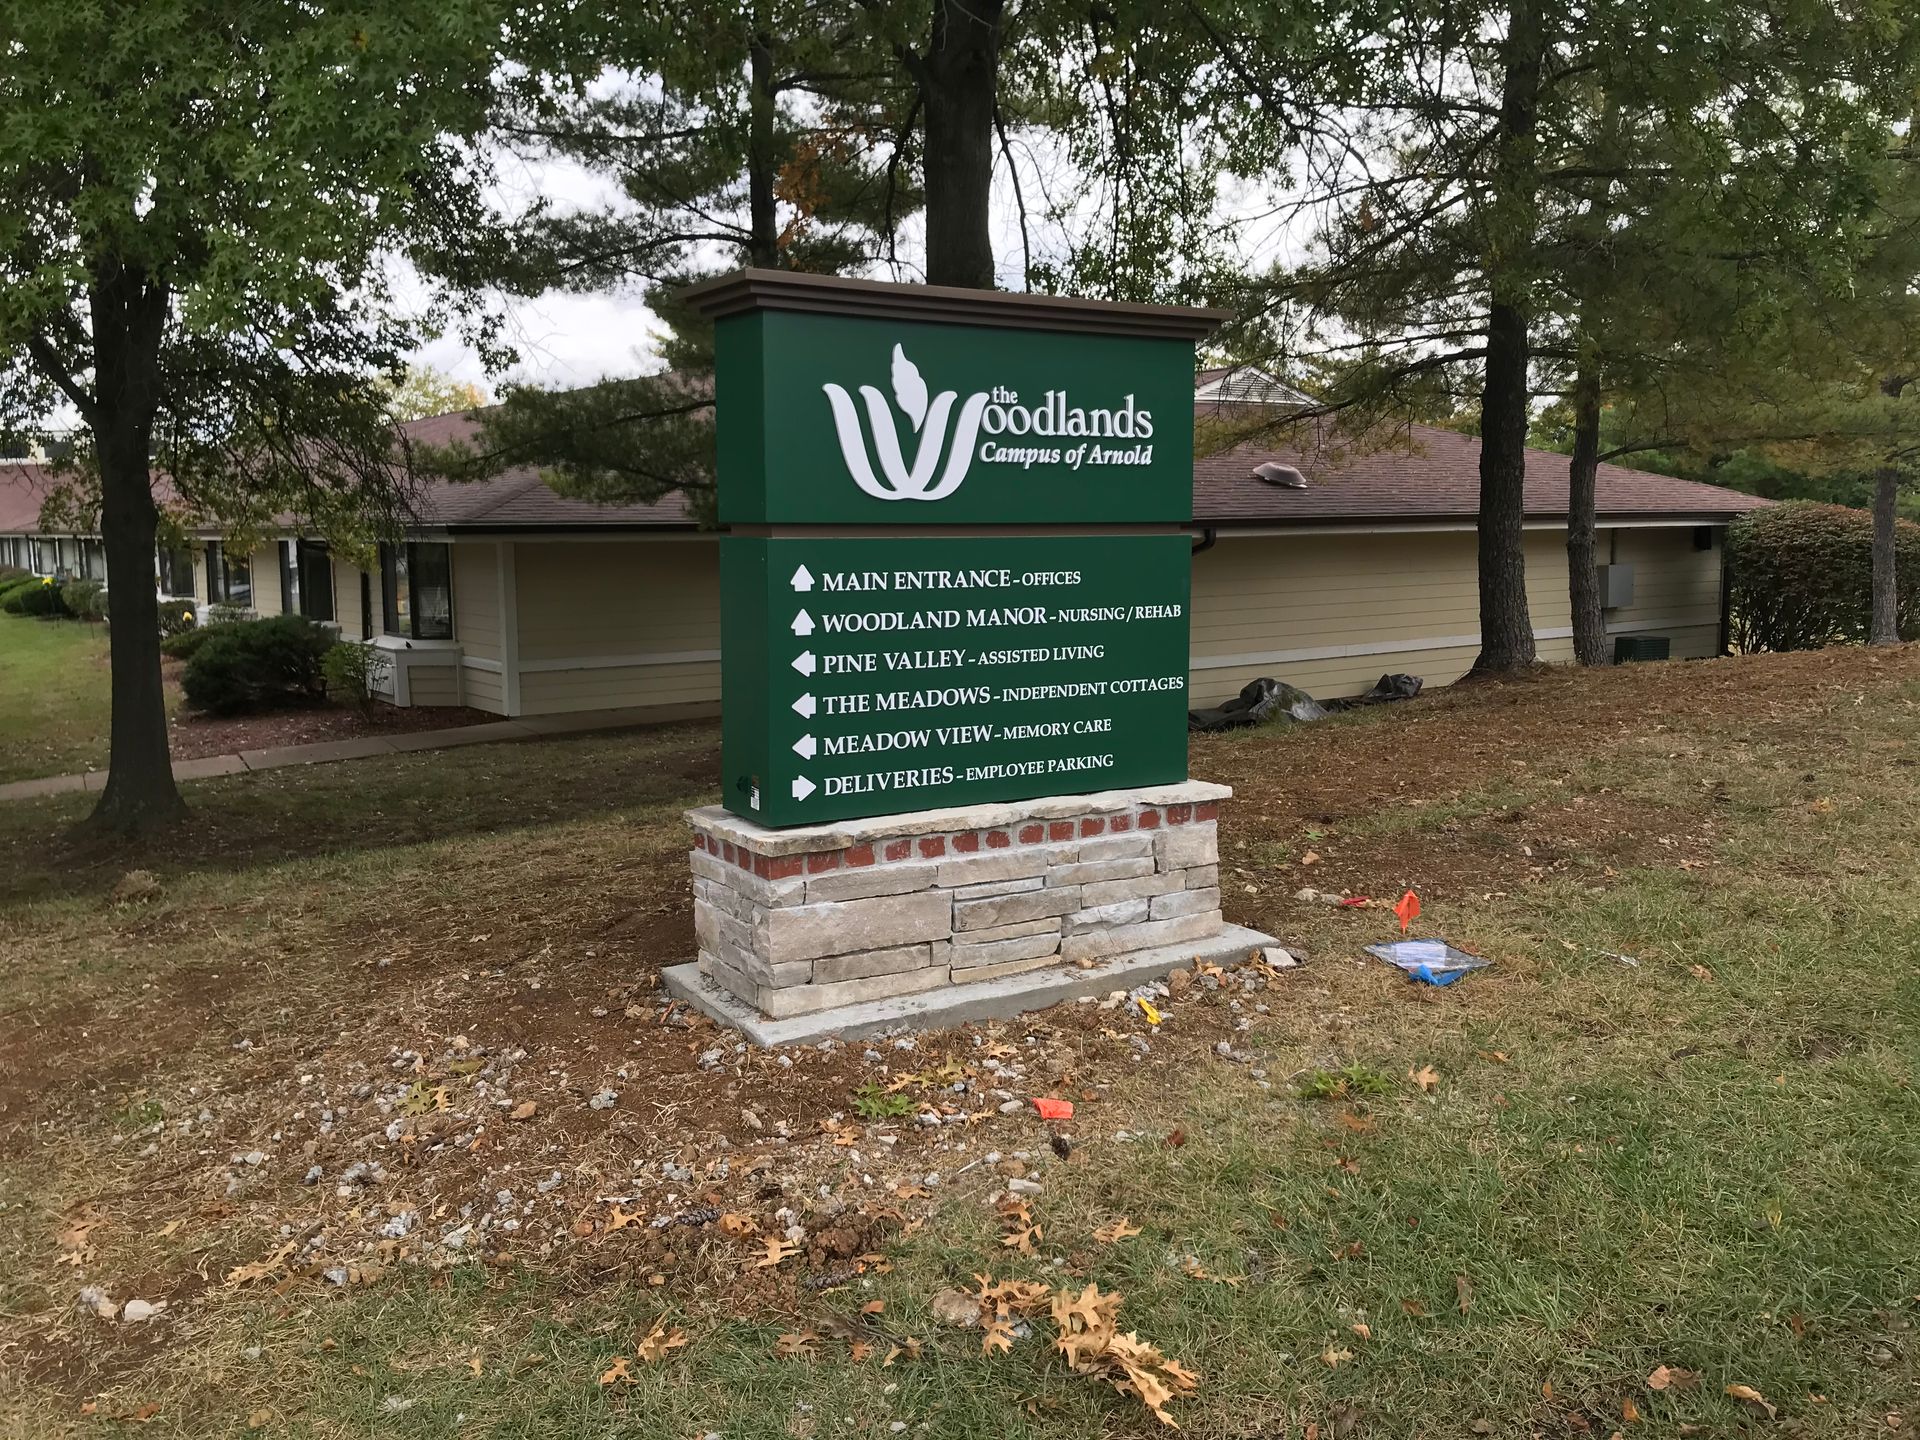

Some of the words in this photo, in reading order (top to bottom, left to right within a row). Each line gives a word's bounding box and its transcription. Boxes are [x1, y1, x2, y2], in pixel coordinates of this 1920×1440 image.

[990, 385, 1019, 405] the
[979, 441, 1061, 470] Campus
[1064, 442, 1088, 471] of
[1086, 444, 1153, 466] Arnold
[822, 571, 889, 592] MAIN
[821, 610, 961, 633] WOODLAND
[823, 653, 877, 674] PINE
[1052, 644, 1105, 661] LIVING
[822, 694, 870, 715] THE
[1110, 676, 1184, 694] COTTAGES
[823, 729, 932, 756] MEADOW
[1073, 718, 1112, 734] CARE
[1047, 753, 1114, 773] PARKING
